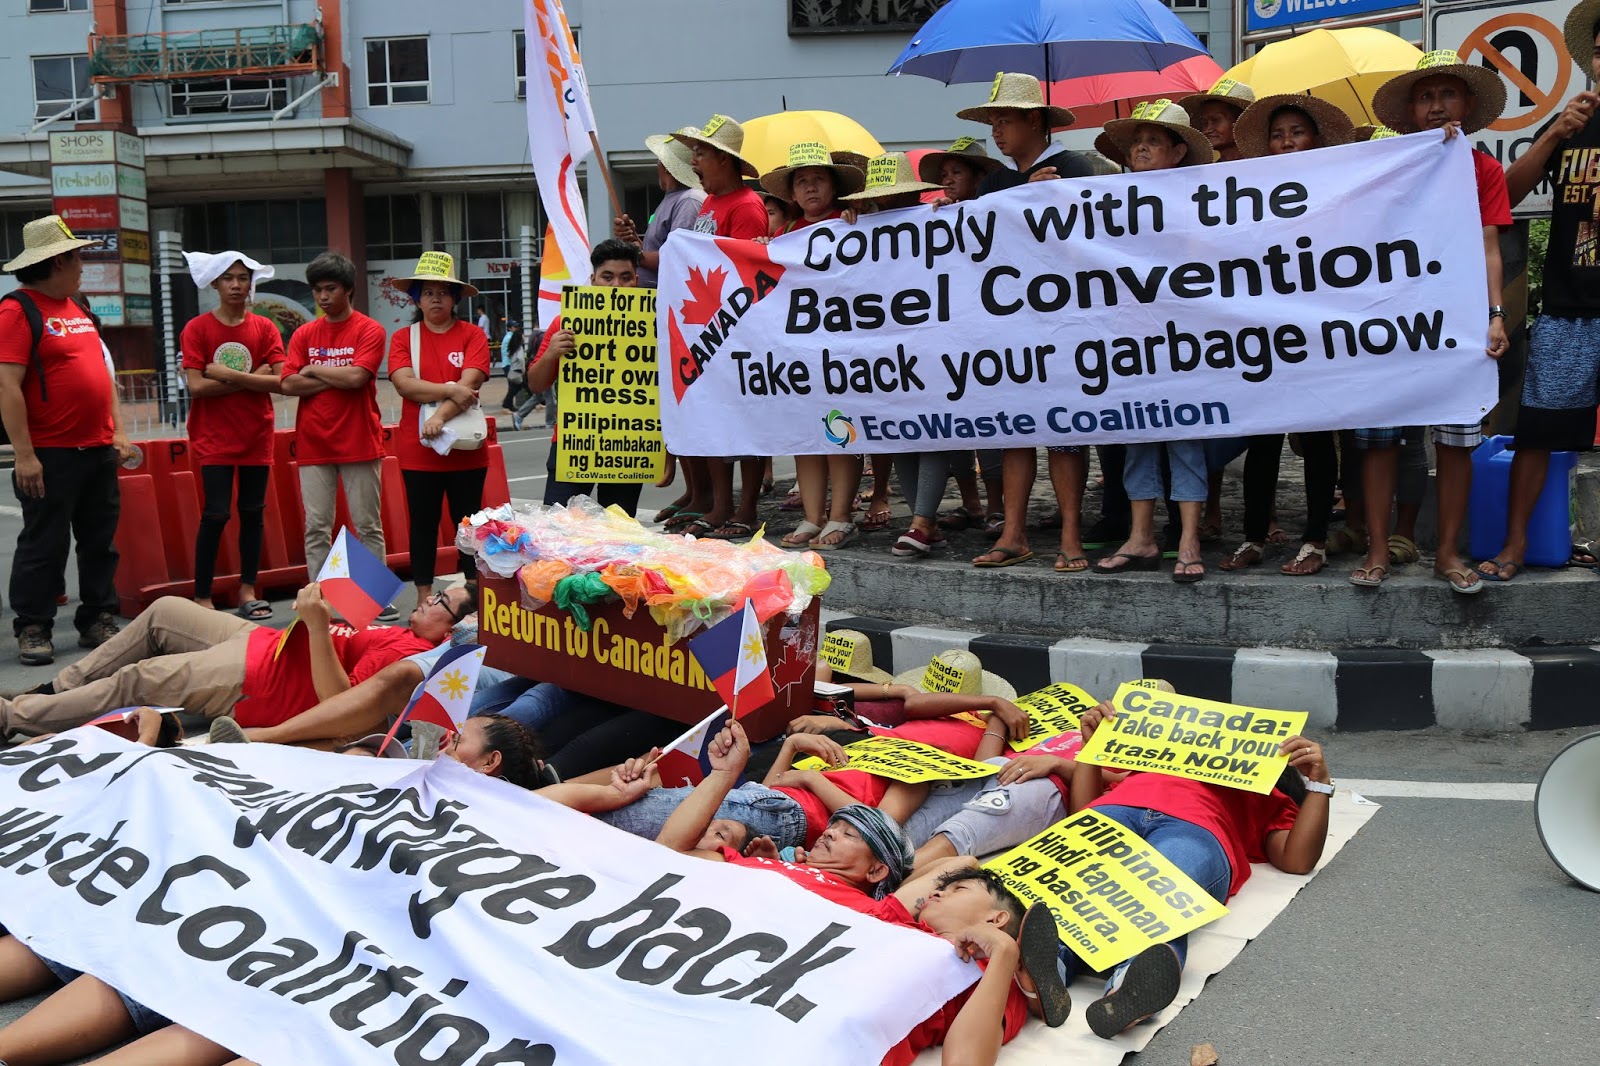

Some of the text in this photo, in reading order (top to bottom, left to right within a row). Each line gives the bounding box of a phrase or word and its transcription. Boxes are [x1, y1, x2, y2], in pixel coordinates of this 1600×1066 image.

[60, 135, 104, 148] SHOPS
[790, 142, 827, 151] Canada:
[883, 167, 896, 175] your
[1563, 185, 1590, 203] EST.
[804, 176, 1309, 270] Comply with the
[431, 266, 447, 274] NOW.
[487, 263, 510, 273] NEW
[785, 236, 1442, 334] Basel Convention.
[91, 303, 121, 313] urrito
[562, 286, 605, 311] Time
[611, 288, 635, 312] for
[561, 313, 647, 338] countries
[679, 269, 778, 387] CANADA
[564, 338, 658, 363] sort ou
[730, 310, 1458, 401] Take back your garbage now.
[562, 362, 615, 384] their
[575, 387, 655, 406] mess.
[563, 412, 662, 434] Pilipinas:
[861, 399, 1231, 440] EcoWaste Coalition
[563, 433, 661, 452] Hindi tambakan
[569, 451, 655, 472] ng basura.
[617, 472, 655, 480] Coalition
[483, 587, 560, 646] Return
[564, 619, 588, 659] to
[593, 617, 684, 686] Canada
[827, 655, 846, 667] NOW.
[837, 649, 852, 657] your
[931, 658, 963, 679] anada:
[932, 670, 960, 688] back your
[1122, 690, 1293, 737] Canada:
[1111, 712, 1281, 759] Take back your
[885, 750, 963, 777] tapunan
[1103, 739, 1177, 762] trash
[1183, 751, 1260, 777] NOW.
[1110, 756, 1253, 786] EcoWaste Coalition
[1064, 814, 1206, 919] Pilipinas:
[1027, 831, 1171, 939] Hindi tapunan
[1007, 855, 1120, 944] ng basura.
[1049, 906, 1100, 955] Coalition
[543, 873, 857, 1024] back.
